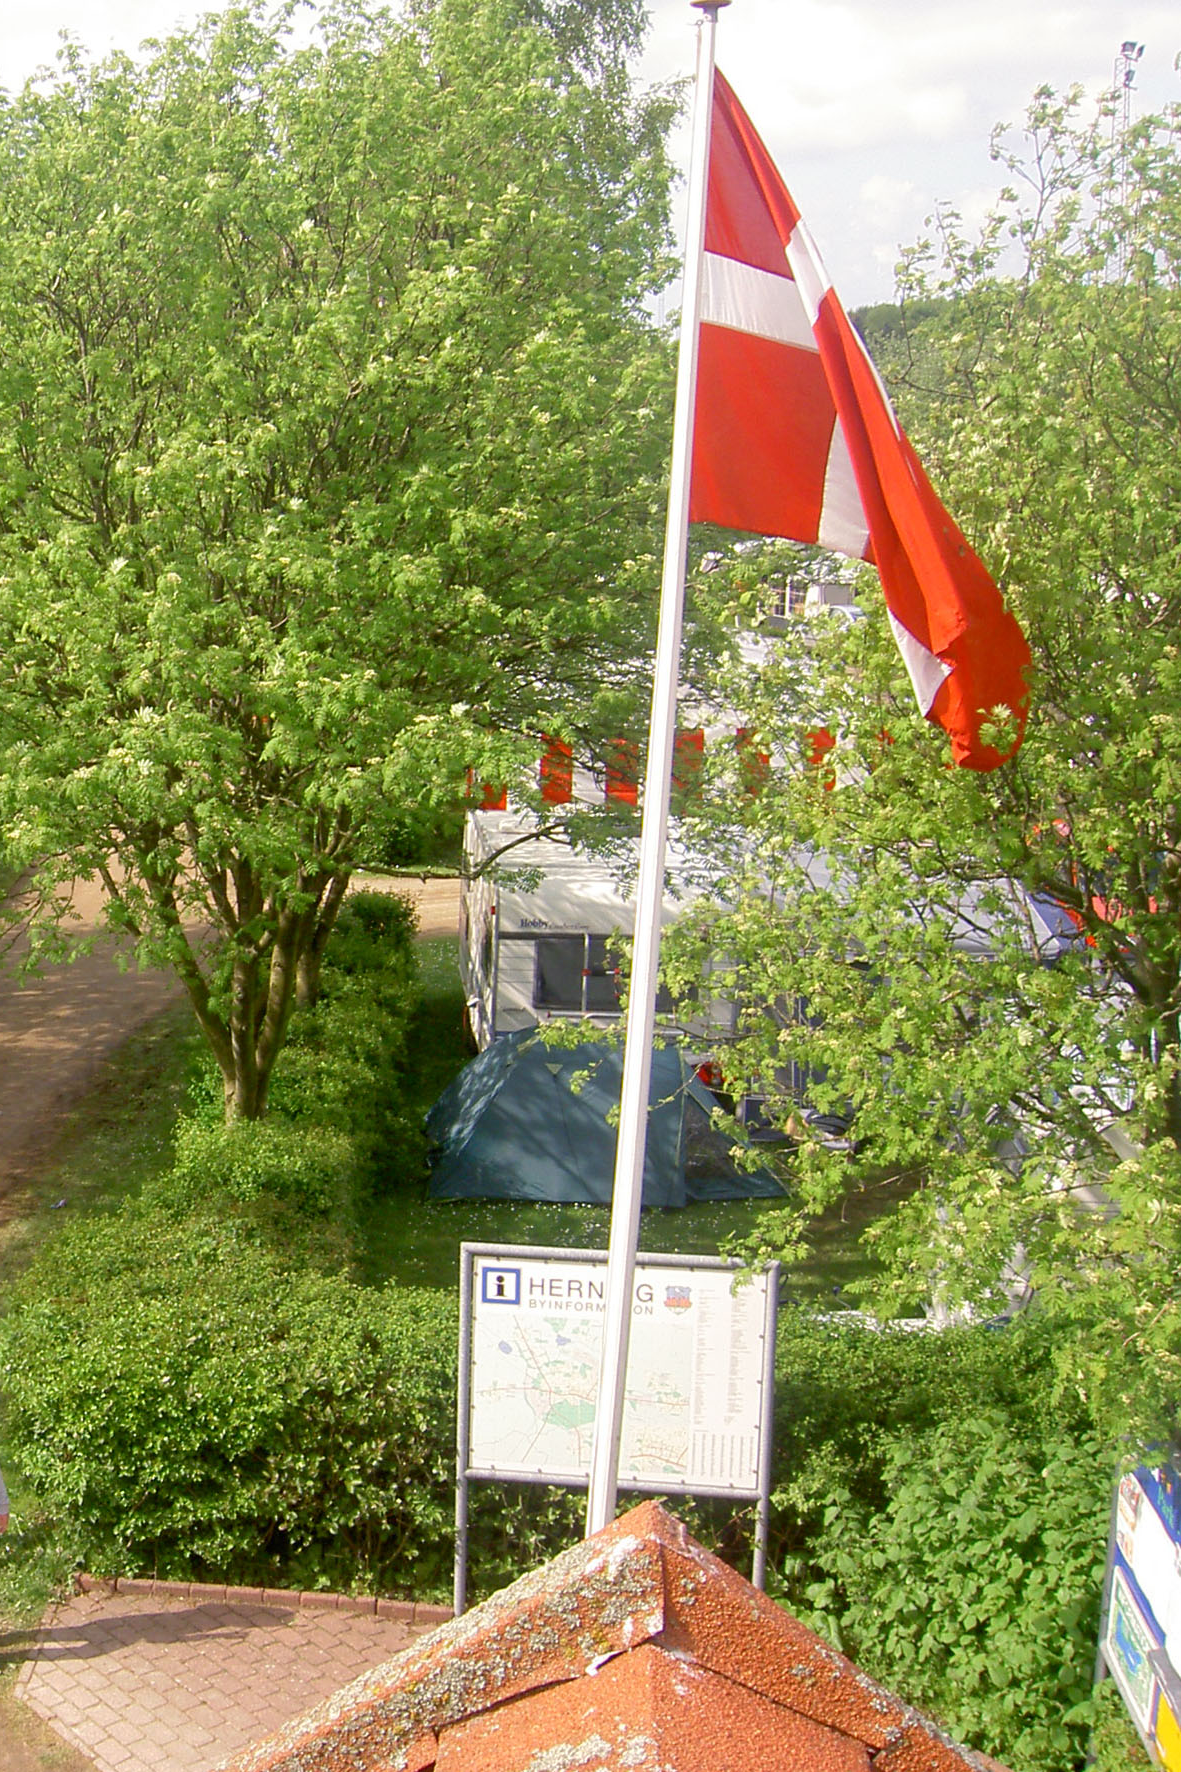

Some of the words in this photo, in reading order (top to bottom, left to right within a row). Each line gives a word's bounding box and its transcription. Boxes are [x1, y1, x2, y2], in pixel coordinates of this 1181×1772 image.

[520, 918, 548, 929] Hobby
[529, 1277, 654, 1303] HERNG
[529, 1299, 653, 1316] BYINFORMON
